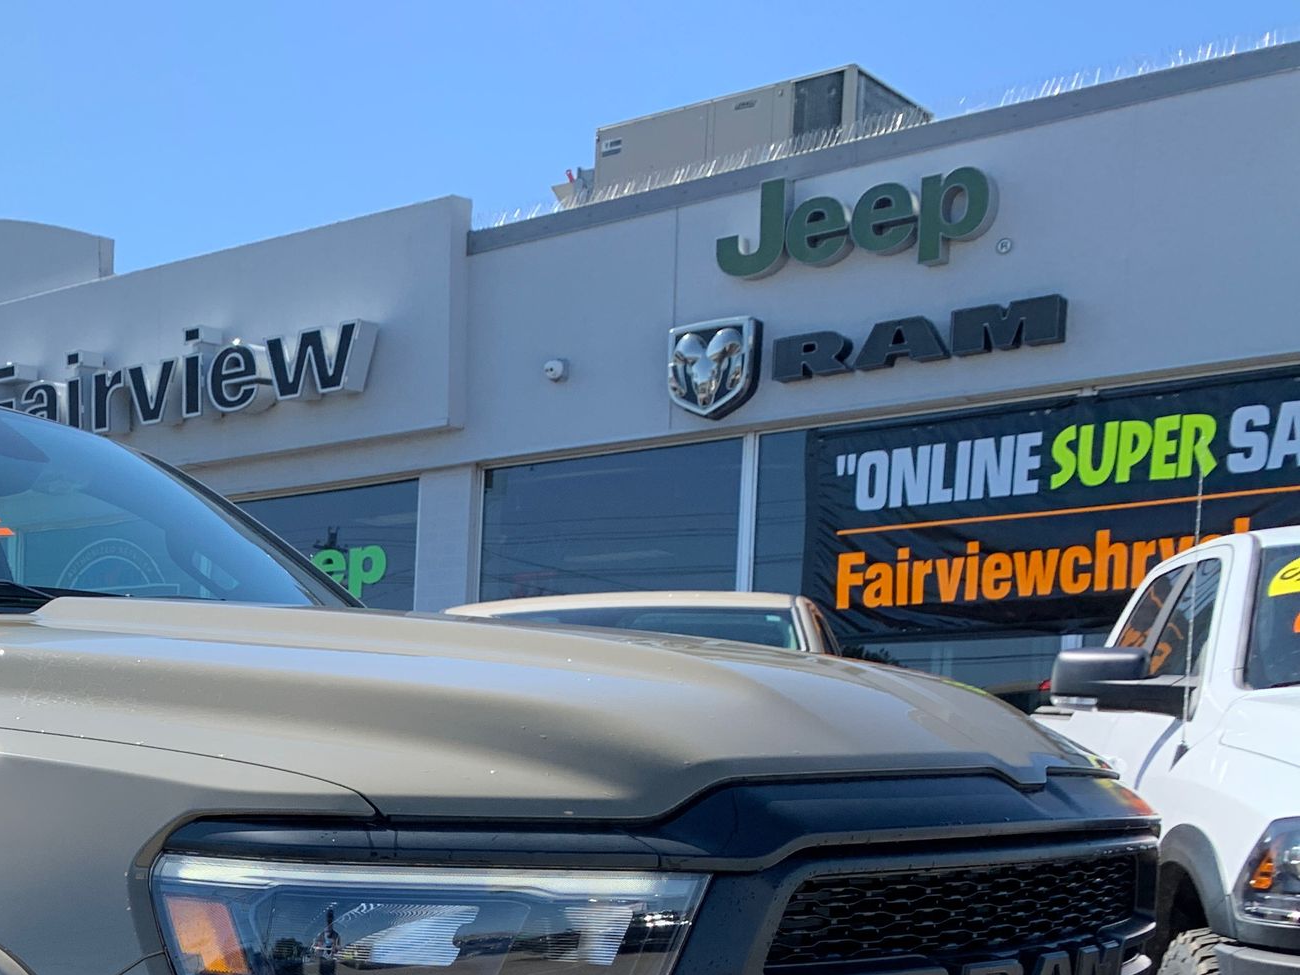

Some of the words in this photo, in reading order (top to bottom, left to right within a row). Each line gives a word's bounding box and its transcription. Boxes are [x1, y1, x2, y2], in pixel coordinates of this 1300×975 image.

[715, 165, 997, 280] Jeep
[771, 293, 1068, 383] RAM
[836, 430, 1044, 511] "ONLINE
[1049, 413, 1218, 491] SUPER
[1226, 400, 1300, 474] SA
[836, 517, 1250, 610] Fairviewchr
